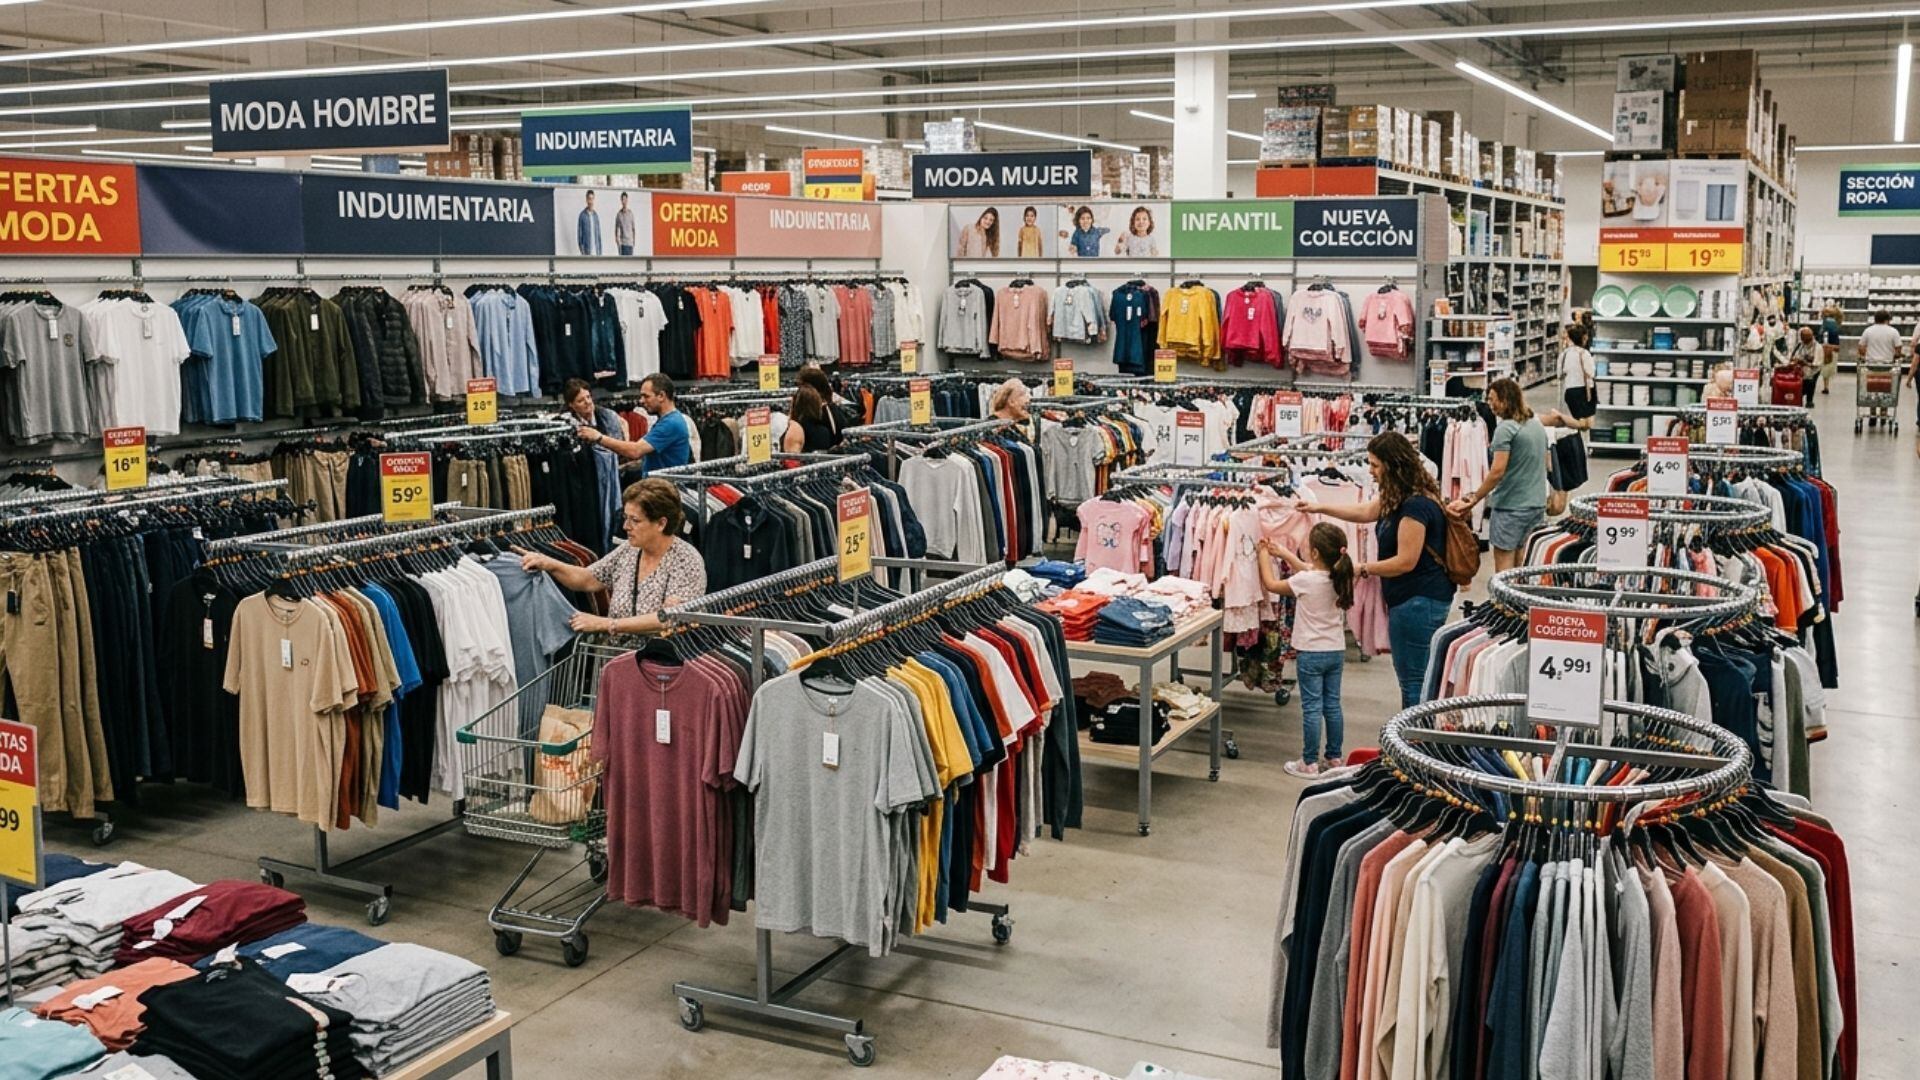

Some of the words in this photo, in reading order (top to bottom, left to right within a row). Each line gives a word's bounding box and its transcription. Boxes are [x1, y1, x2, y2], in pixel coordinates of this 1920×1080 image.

[220, 101, 306, 132] MODA
[313, 93, 437, 128] HOMBRE
[535, 128, 677, 151] INDUMENTARIA
[925, 167, 995, 187] MODA
[1002, 165, 1079, 186] MUJER
[1846, 173, 1915, 189] SECCIÓN
[1846, 192, 1888, 204] ROPA
[659, 202, 728, 224] OFERTAS
[1181, 212, 1282, 231] INFANTIL
[1322, 209, 1391, 226] NUEVA
[671, 228, 719, 248] MODA
[1299, 225, 1413, 246] COLECCIÓN
